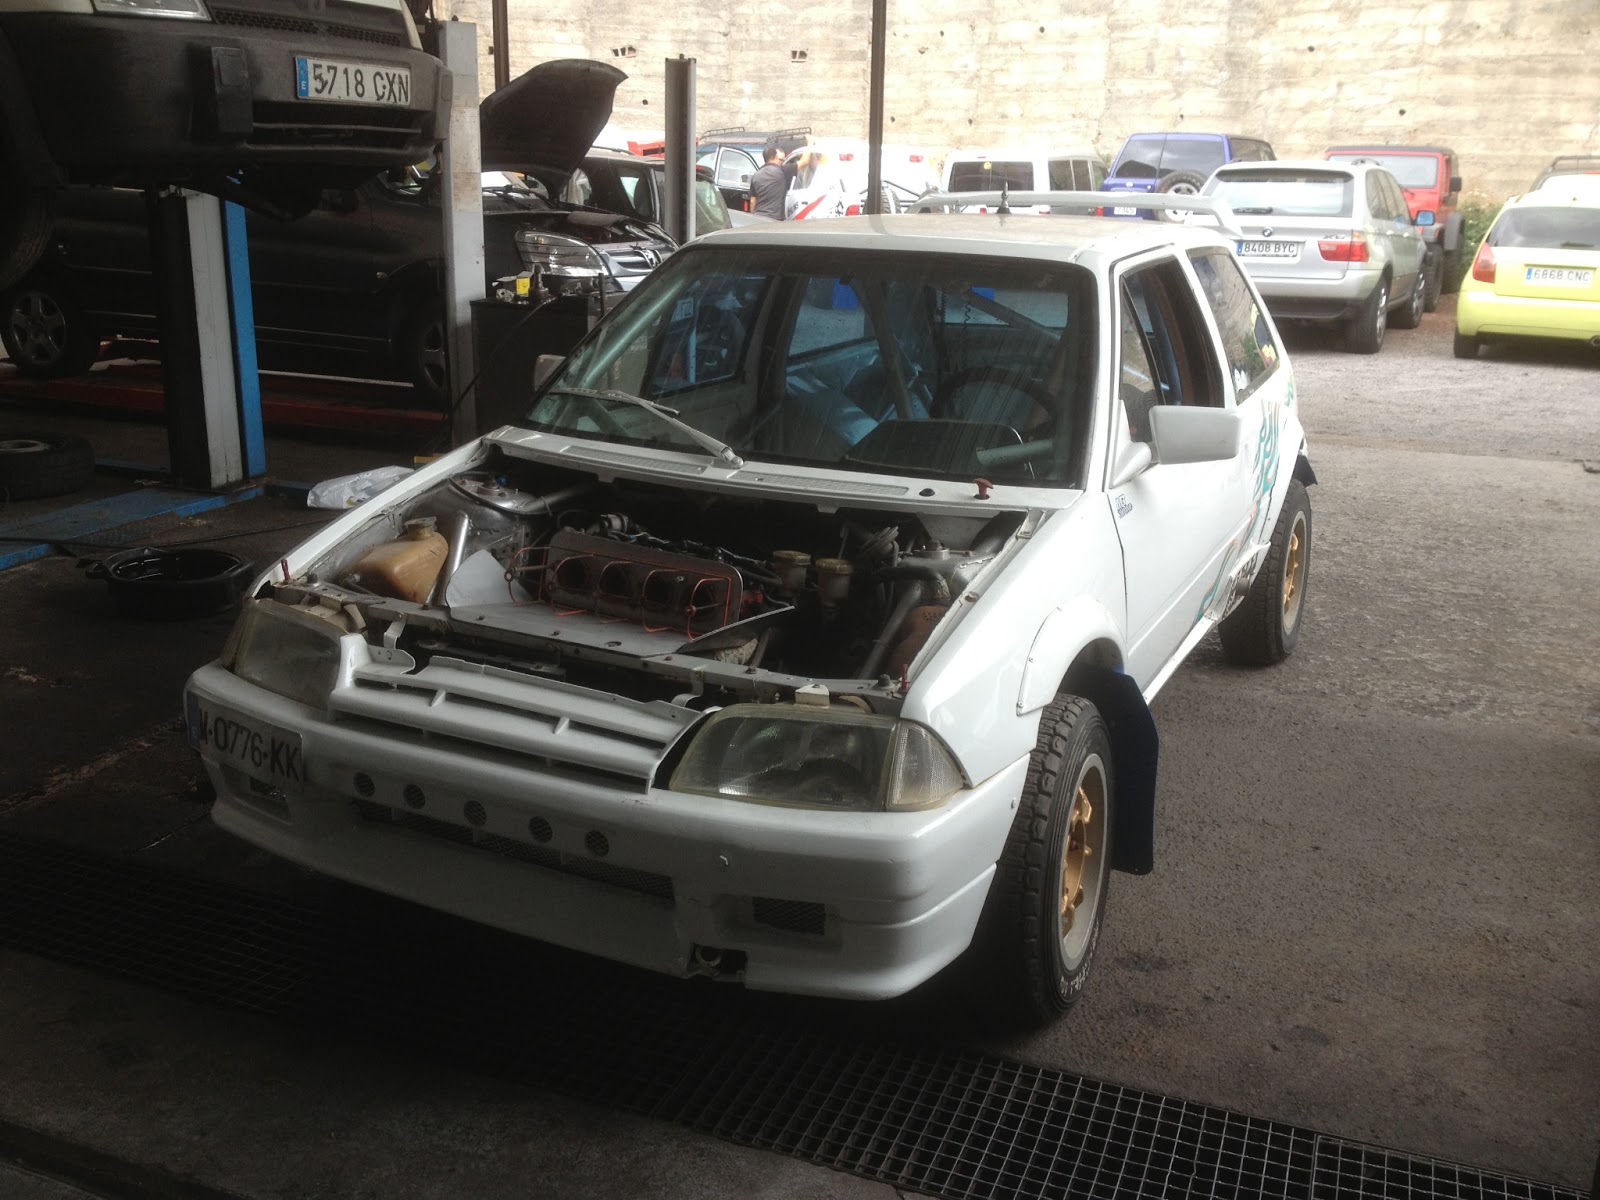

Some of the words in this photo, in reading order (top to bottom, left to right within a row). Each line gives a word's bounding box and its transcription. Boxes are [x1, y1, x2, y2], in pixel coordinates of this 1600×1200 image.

[312, 63, 366, 98] 5718
[373, 71, 409, 103] CXN
[1244, 242, 1271, 253] 8408
[1273, 243, 1295, 254] BYC
[1534, 269, 1563, 280] 6868
[1567, 271, 1590, 281] CNC
